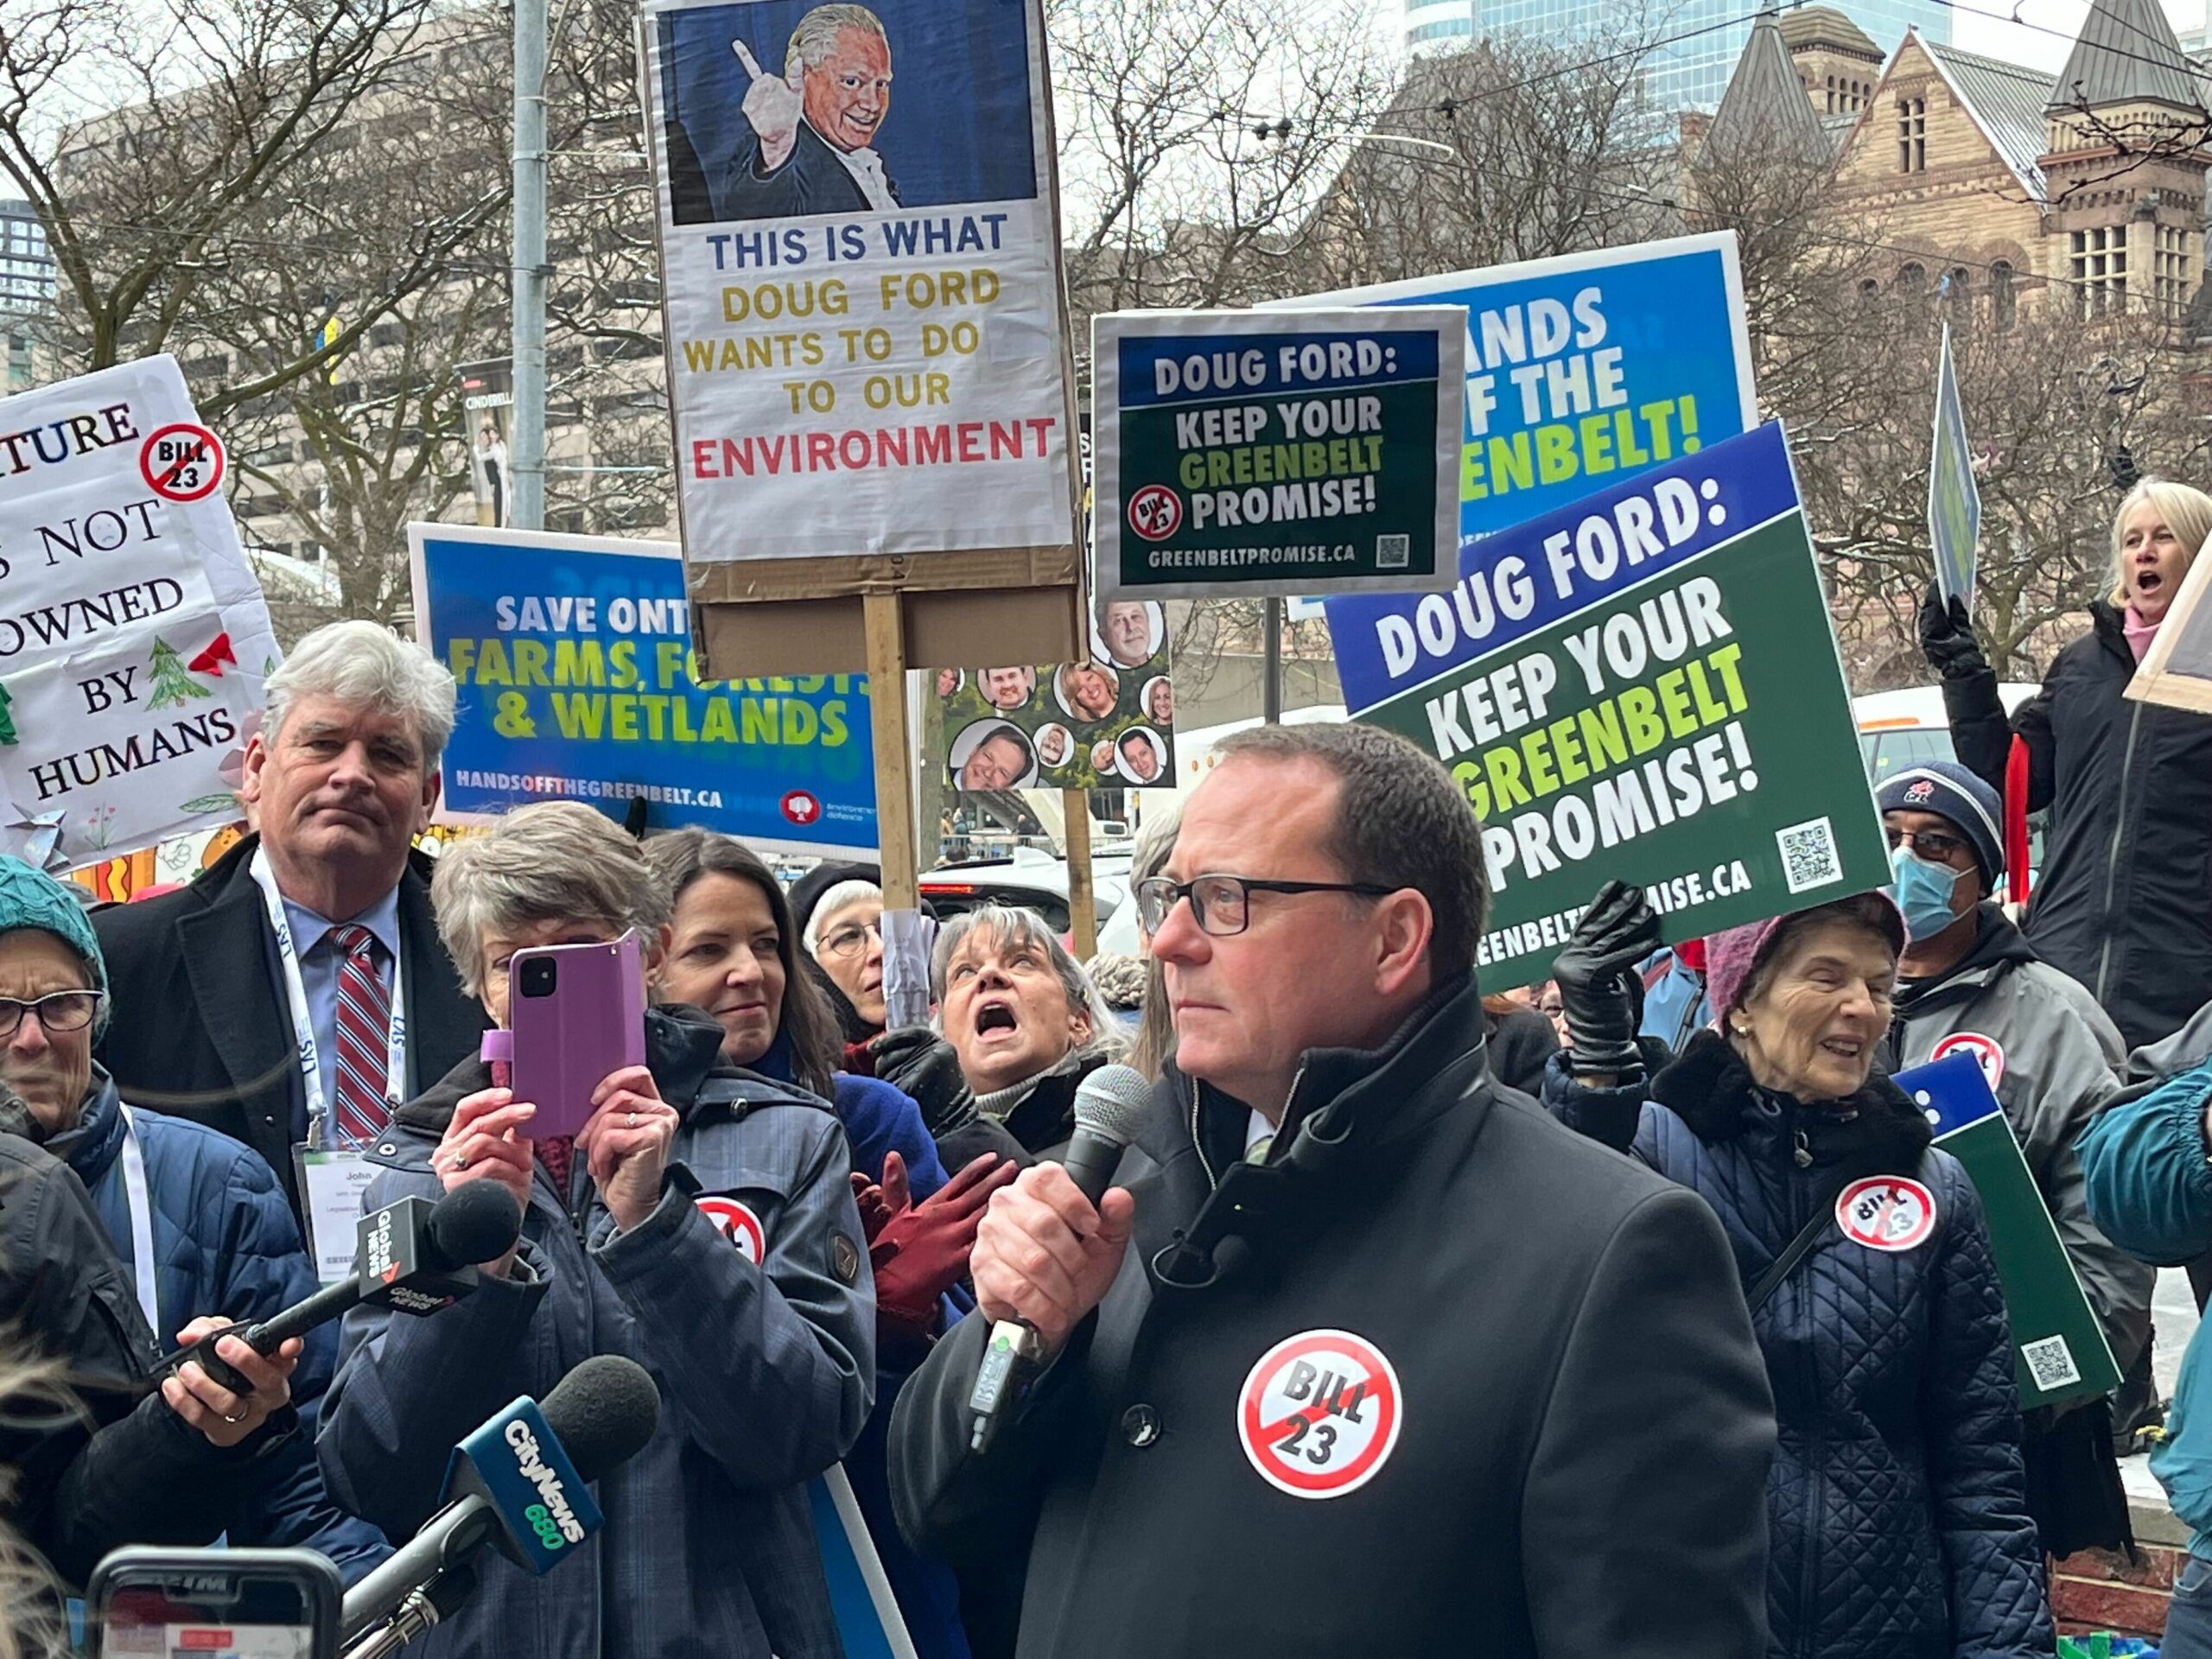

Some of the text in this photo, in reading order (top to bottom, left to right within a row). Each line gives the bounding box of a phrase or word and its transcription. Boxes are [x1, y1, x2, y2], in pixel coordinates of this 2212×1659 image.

[707, 213, 1007, 270] THIS IS WHAT
[722, 268, 1001, 322] DOUG FORD
[682, 321, 980, 373] WANTS TO DO
[1154, 339, 1397, 396] DOUG FORD:
[466, 391, 515, 410] CINDERELL
[783, 372, 950, 415] TO OUR
[1510, 346, 1628, 426] THE
[0, 403, 140, 476] TURE
[692, 417, 1056, 479] ENVIRONMENT
[1176, 396, 1382, 450] KEEP YOUR
[1461, 394, 1700, 503] ENBELT!
[159, 441, 208, 463] BILL
[167, 467, 199, 488] 23
[1179, 435, 1383, 490] GREENBELT
[1138, 493, 1169, 518] BILL
[1149, 512, 1170, 531] 23
[1191, 474, 1376, 531] PROMISE!
[34, 499, 162, 567] NOT
[1148, 543, 1356, 569] GREENBELTPROMISE.CA
[1375, 475, 1727, 680] DOUG FORD:
[0, 577, 183, 656] OWNED
[496, 595, 597, 633] SAVE
[78, 666, 139, 715] BY
[449, 638, 646, 692] FARMS,
[1425, 575, 1733, 761] KEEP YOUR
[493, 690, 849, 747] & WETLANDS
[1451, 643, 1749, 823] GREENBELT
[29, 708, 237, 800] HUMANS
[456, 769, 724, 810] HANDSOFFTHEGREENBELT.CA
[1481, 721, 1759, 893] PROMISE!
[276, 922, 293, 958] LAS
[298, 1039, 316, 1075] LAS
[392, 1015, 406, 1048] LAS
[346, 1172, 372, 1181] John
[1853, 1189, 1908, 1221] BILL
[1877, 1212, 1914, 1238] 23
[367, 1230, 381, 1279] NEWS
[378, 1210, 393, 1274] Global
[1282, 1359, 1368, 1425] BILL
[1276, 1414, 1338, 1465] 23
[524, 1503, 566, 1550] 680
